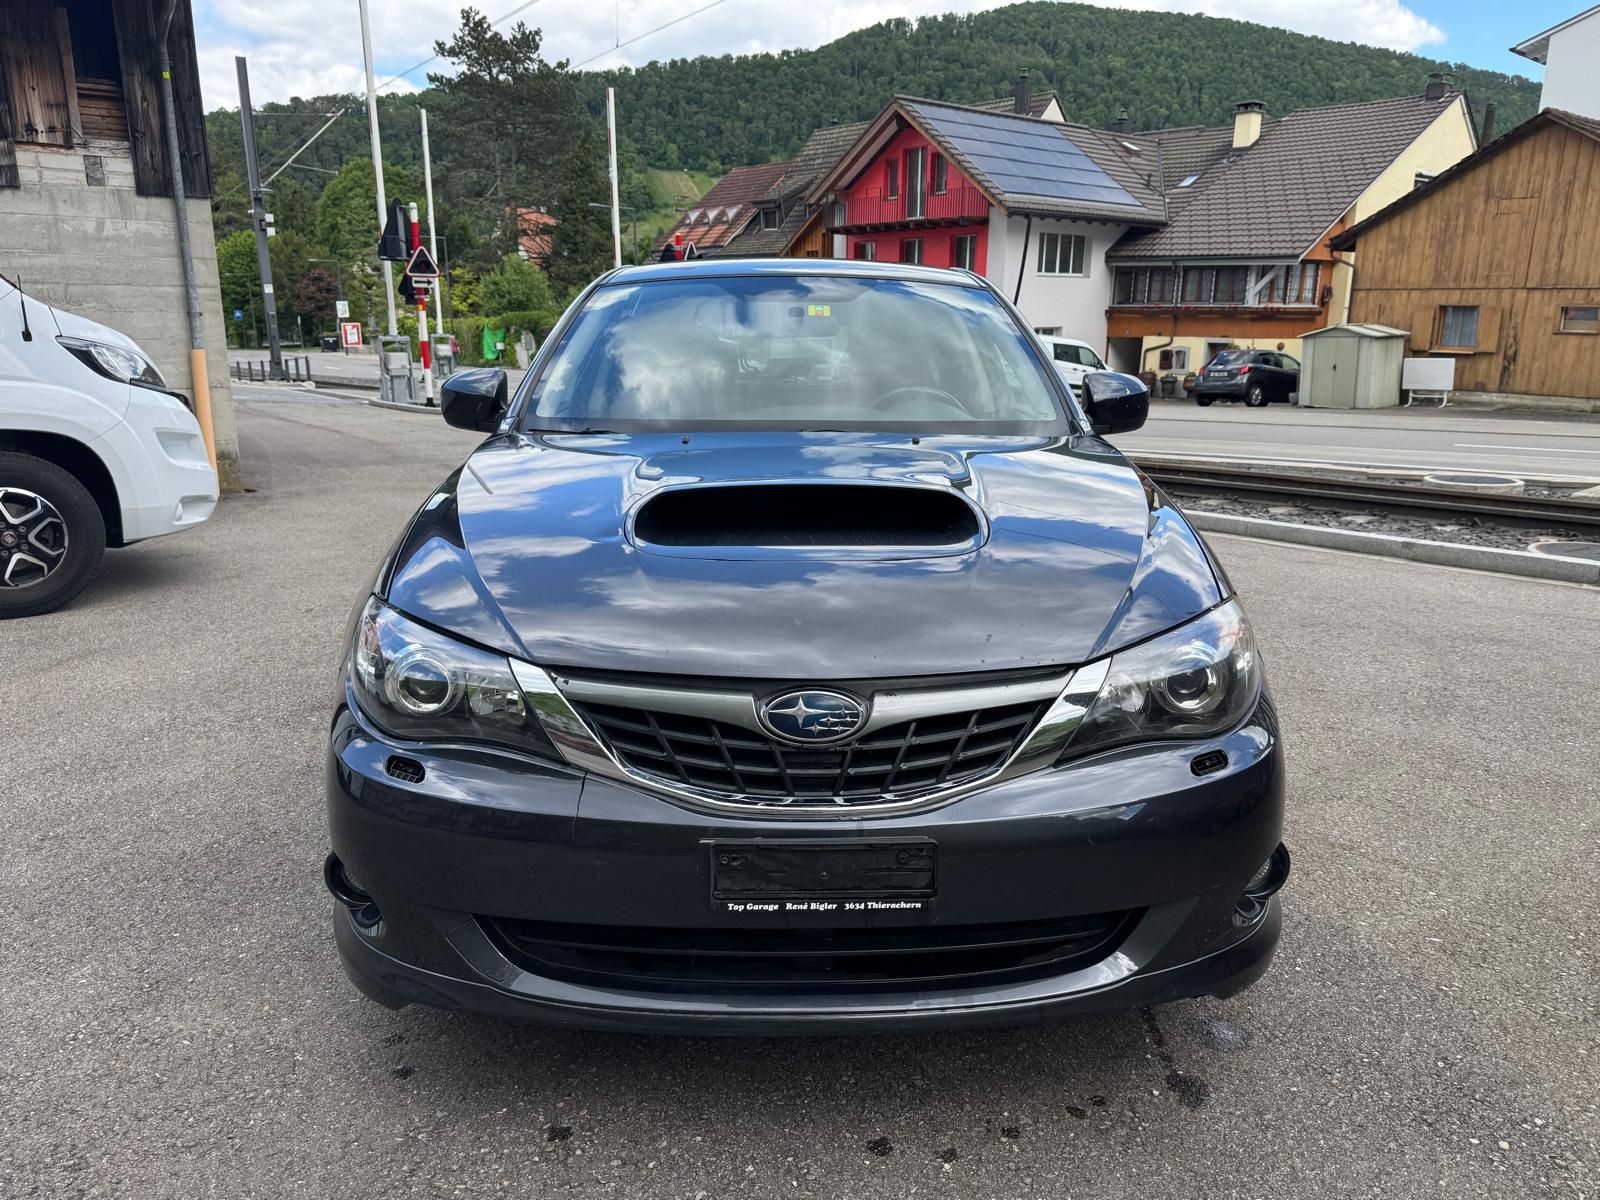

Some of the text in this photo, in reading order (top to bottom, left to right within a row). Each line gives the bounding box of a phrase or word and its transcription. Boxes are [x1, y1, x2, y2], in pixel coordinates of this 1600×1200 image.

[728, 903, 744, 912] Top
[746, 903, 779, 912] Garage
[786, 902, 808, 910] René
[810, 902, 838, 911] Bigler
